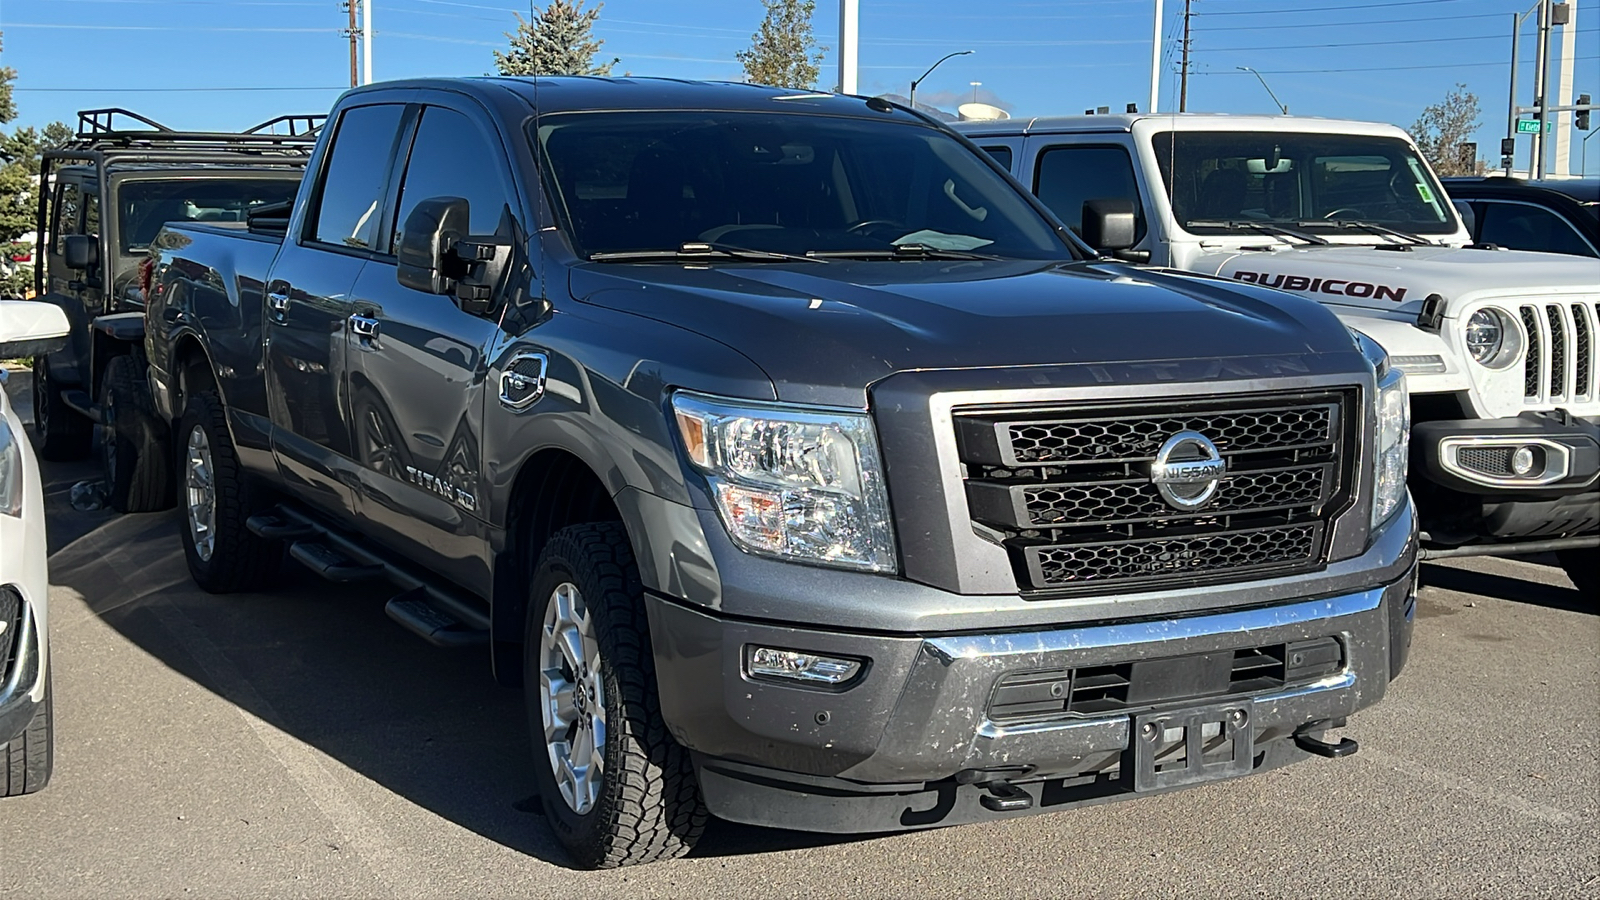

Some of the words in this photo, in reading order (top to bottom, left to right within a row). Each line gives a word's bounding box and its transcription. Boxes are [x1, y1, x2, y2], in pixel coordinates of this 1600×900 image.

[1233, 271, 1407, 302] RUBICON
[1004, 356, 1309, 386] TITAN
[1163, 465, 1222, 479] NISSAN
[406, 465, 454, 500] TITAN
[456, 488, 475, 511] XD
